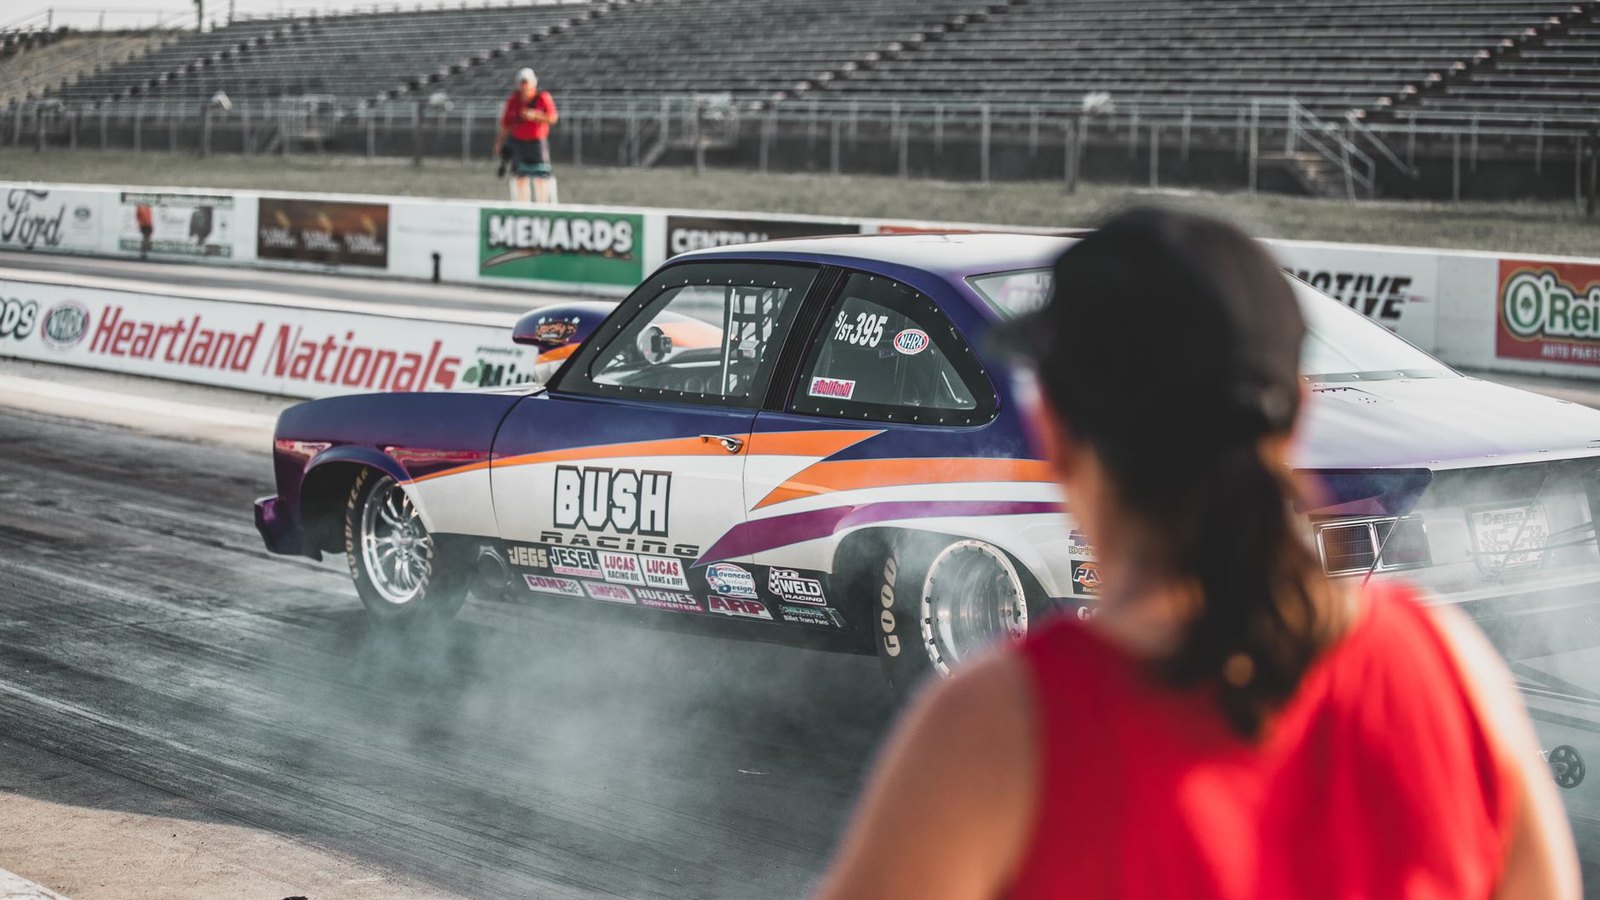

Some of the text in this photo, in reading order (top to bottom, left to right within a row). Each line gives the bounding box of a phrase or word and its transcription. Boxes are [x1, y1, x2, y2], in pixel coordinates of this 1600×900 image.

[1, 189, 65, 250] Ford
[488, 215, 633, 253] MENARDS
[849, 312, 889, 348] 395
[89, 305, 461, 392] Heartland Nationals
[900, 334, 923, 350] NHRA
[1571, 347, 1600, 360] PART
[553, 464, 672, 538] BUSH
[540, 530, 700, 558] RACING
[507, 546, 549, 569] JEGS
[550, 548, 601, 571] JESEL
[604, 555, 635, 571] LUCAS
[607, 570, 629, 580] RACING
[630, 573, 640, 582] OIL
[646, 559, 679, 577] LUCAS
[707, 567, 752, 580] Advanced
[1073, 566, 1101, 583] PA
[527, 575, 568, 590] COMP
[648, 574, 666, 585] TRANS
[672, 577, 683, 586] DIFF
[779, 579, 821, 597] WELD
[588, 583, 630, 600] SIMPSON
[634, 588, 697, 605] HUGHES
[718, 583, 753, 595] Design
[641, 600, 702, 611] CONVERTERS
[709, 597, 765, 615] ARP
[785, 594, 823, 603] RACING
